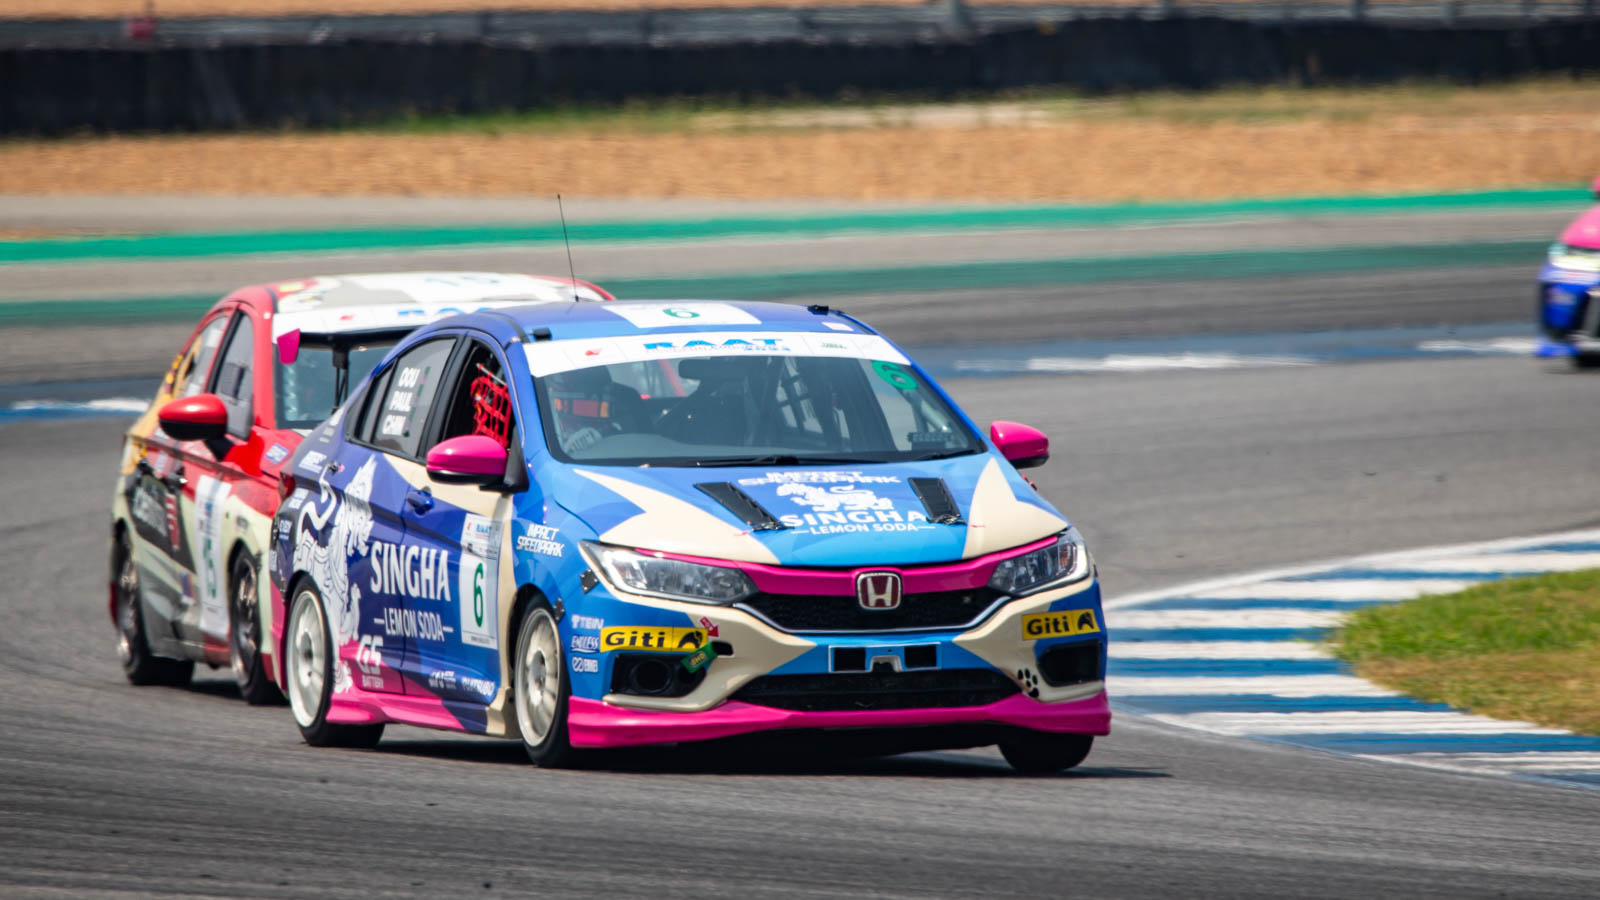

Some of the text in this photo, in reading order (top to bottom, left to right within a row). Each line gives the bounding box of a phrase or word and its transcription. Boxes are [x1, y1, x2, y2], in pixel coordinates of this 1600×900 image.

[662, 307, 701, 319] 6
[642, 338, 784, 350] RAAT
[871, 360, 919, 391] 6
[389, 390, 414, 412] PAUL
[779, 510, 927, 528] SINGHA
[810, 522, 919, 535] LEMON SODA
[370, 541, 452, 602] SINGHA
[473, 562, 484, 628] 6
[384, 607, 445, 642] LEMON SODA
[1026, 615, 1070, 635] Giti
[605, 631, 666, 648] Giti
